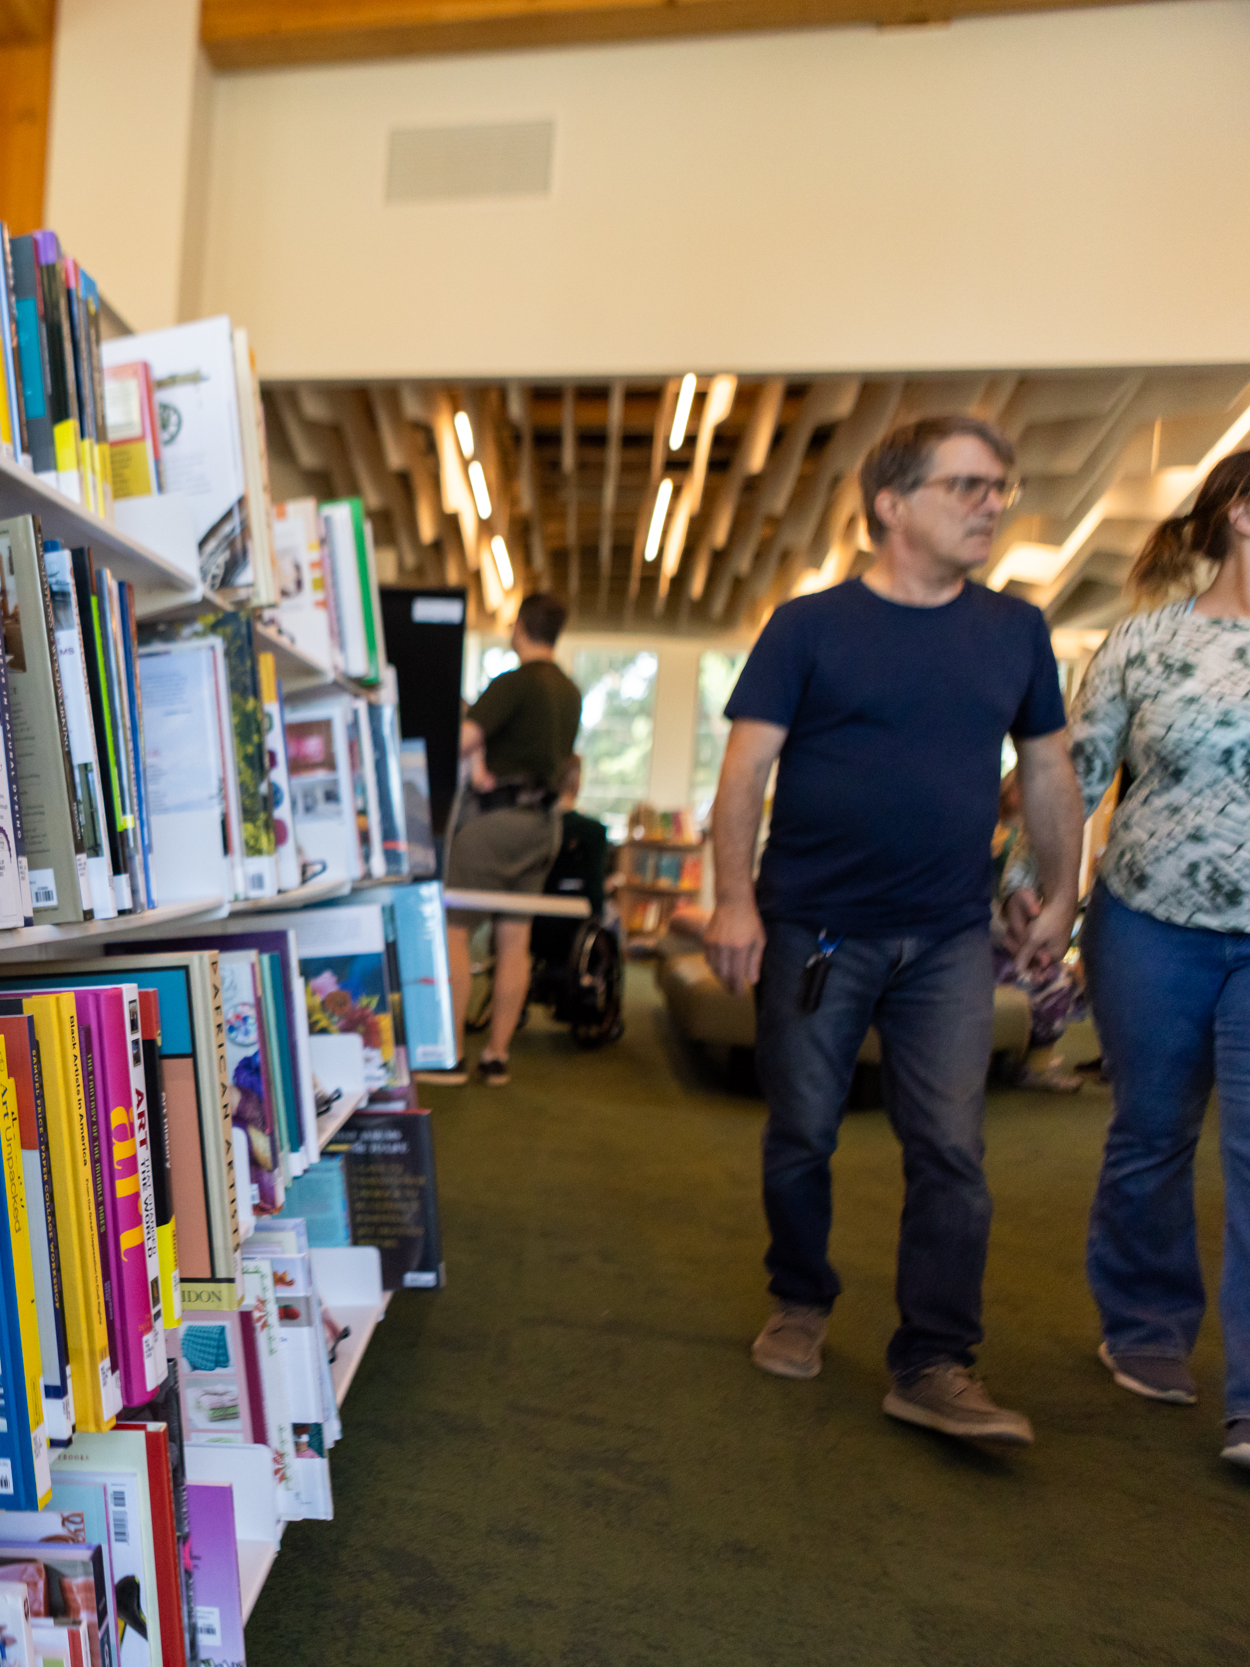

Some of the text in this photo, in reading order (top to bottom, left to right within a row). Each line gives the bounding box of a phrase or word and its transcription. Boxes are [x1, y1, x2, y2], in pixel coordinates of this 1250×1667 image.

[50, 642, 71, 752] WOODWORKING
[5, 712, 15, 777] NATURAL
[12, 784, 22, 840] DYEING
[70, 1015, 78, 1048] Black
[32, 1049, 40, 1096] SAMUEL
[73, 1054, 82, 1099] Artists
[36, 1099, 44, 1135] PRICE
[78, 1114, 88, 1167] America
[89, 1075, 98, 1121] FANTASY
[96, 1162, 105, 1204] MIDDLE
[136, 1088, 149, 1151] ART
[212, 986, 240, 1254] AFRICAN ARTISTS
[0, 1082, 22, 1235] Art Unpacked
[110, 1106, 144, 1262] art
[44, 1184, 54, 1238] COLLAGE
[144, 1198, 154, 1258] WORLD
[48, 1240, 61, 1310] WORKSHOP
